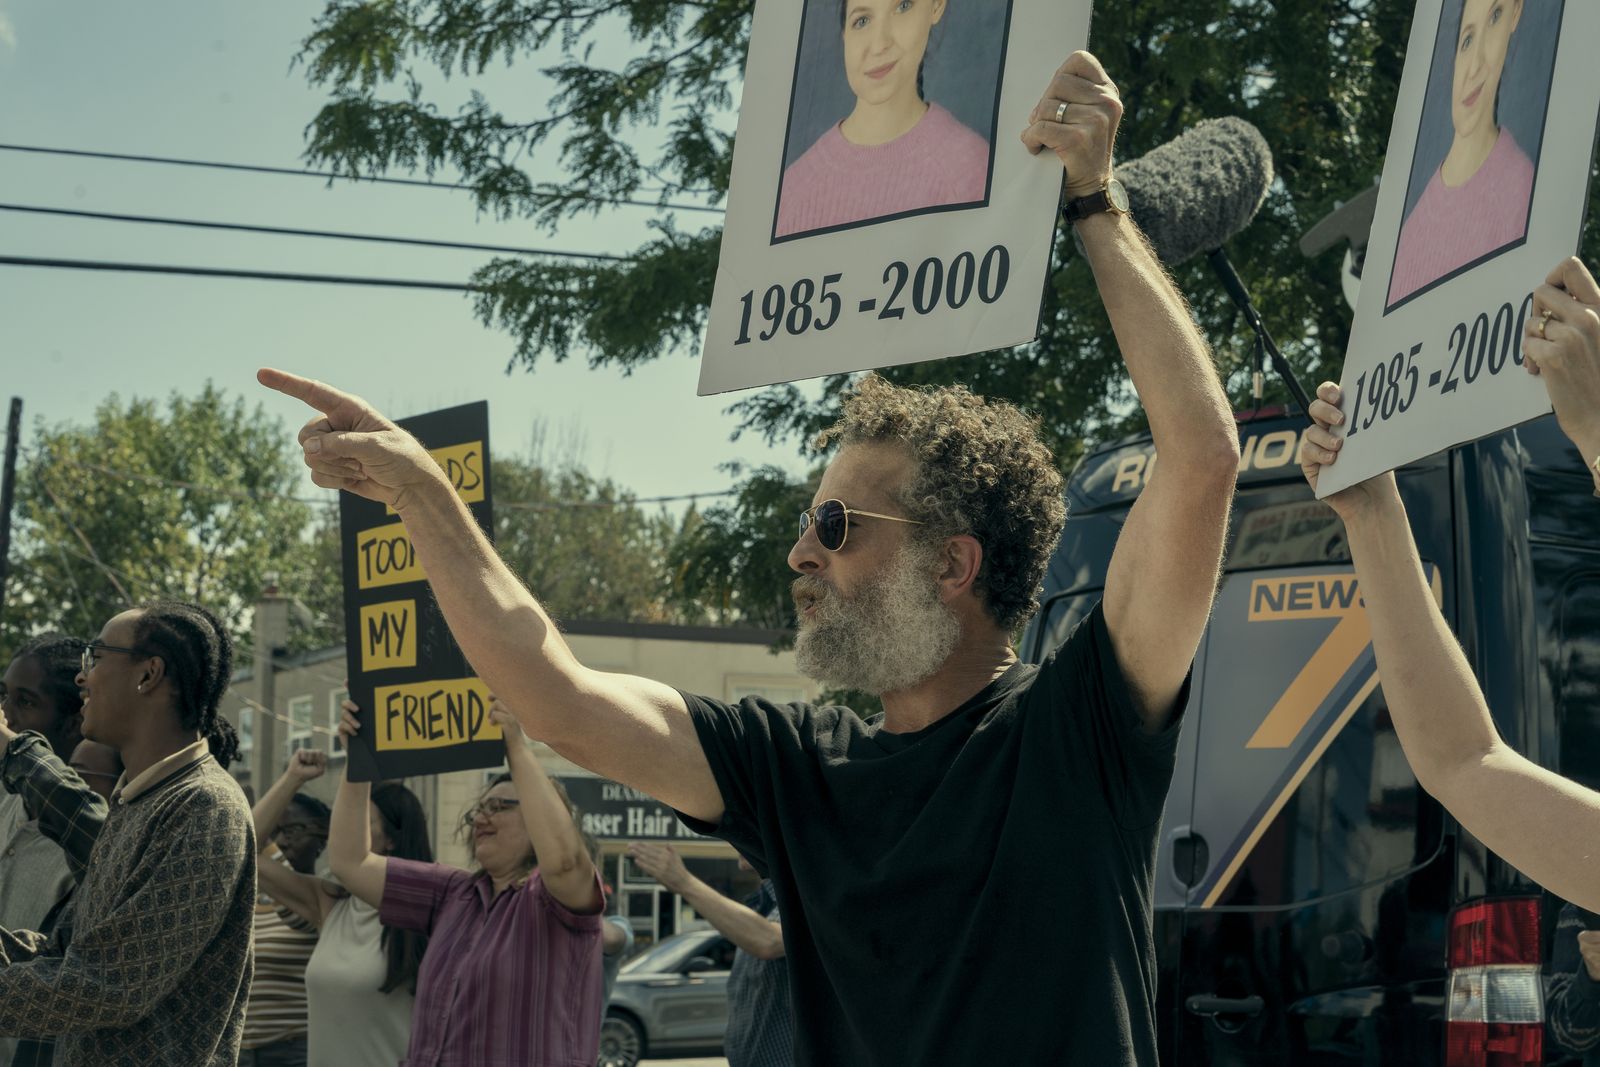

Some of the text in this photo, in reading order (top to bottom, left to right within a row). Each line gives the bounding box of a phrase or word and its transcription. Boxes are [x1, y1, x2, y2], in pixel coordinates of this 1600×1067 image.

[734, 244, 1010, 345] 1985 -2000
[1346, 342, 1423, 437] 1985
[1254, 579, 1366, 614] NEW
[368, 608, 408, 658] MY
[386, 689, 484, 742] FRIEND
[574, 807, 622, 836] aser
[626, 807, 673, 837] Hair
